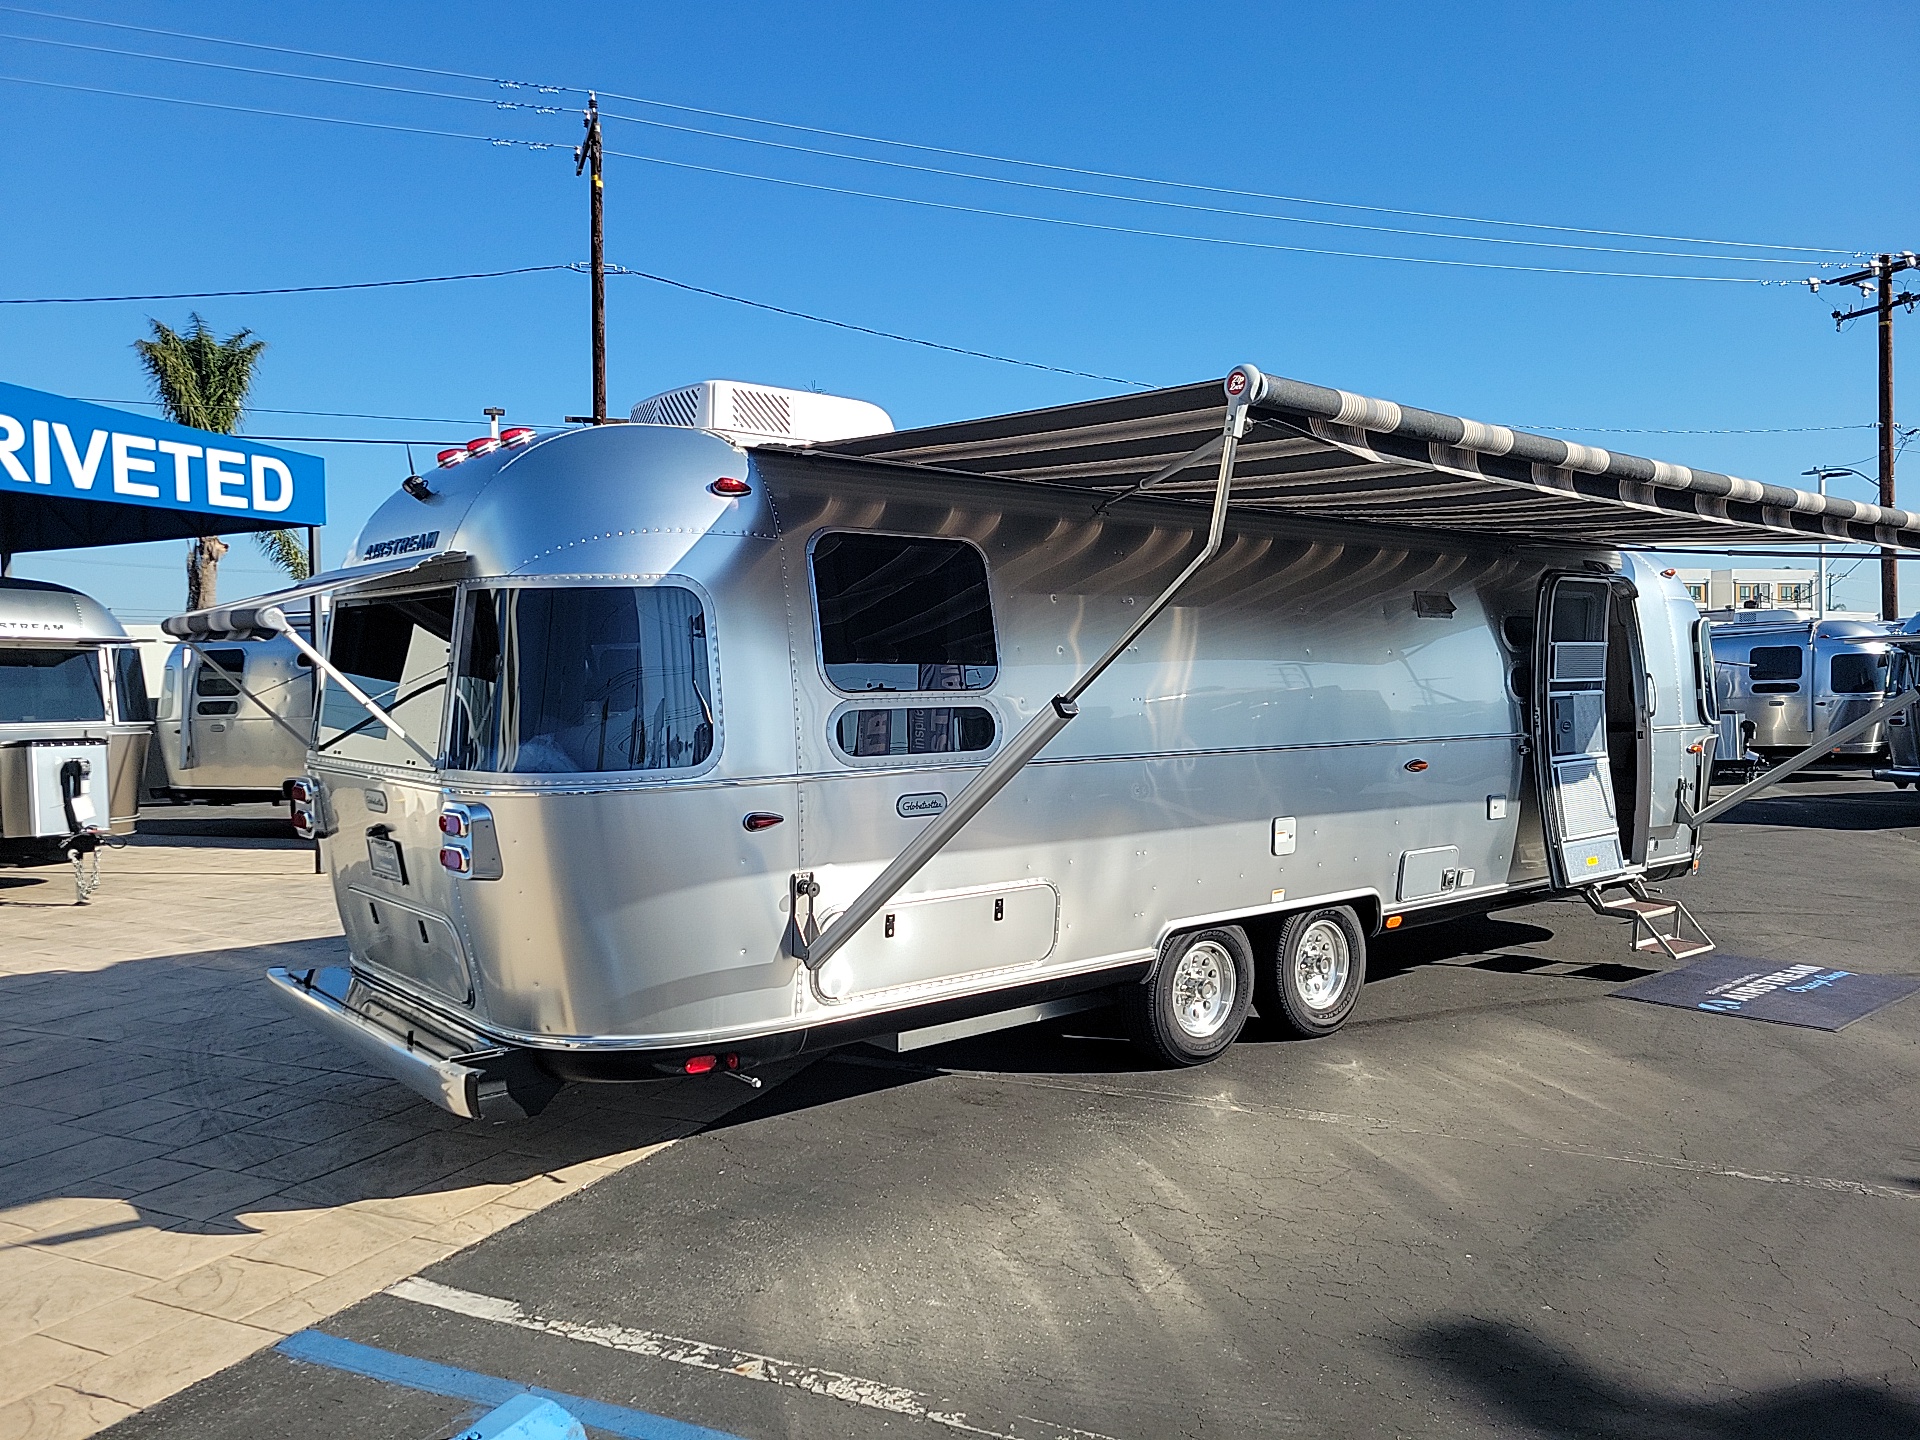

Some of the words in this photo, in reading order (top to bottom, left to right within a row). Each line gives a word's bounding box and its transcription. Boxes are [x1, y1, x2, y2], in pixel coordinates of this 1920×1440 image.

[363, 530, 440, 561] AIRSTREAM
[912, 709, 926, 749] inspire
[1720, 963, 1826, 1002] AIRSTREAM
